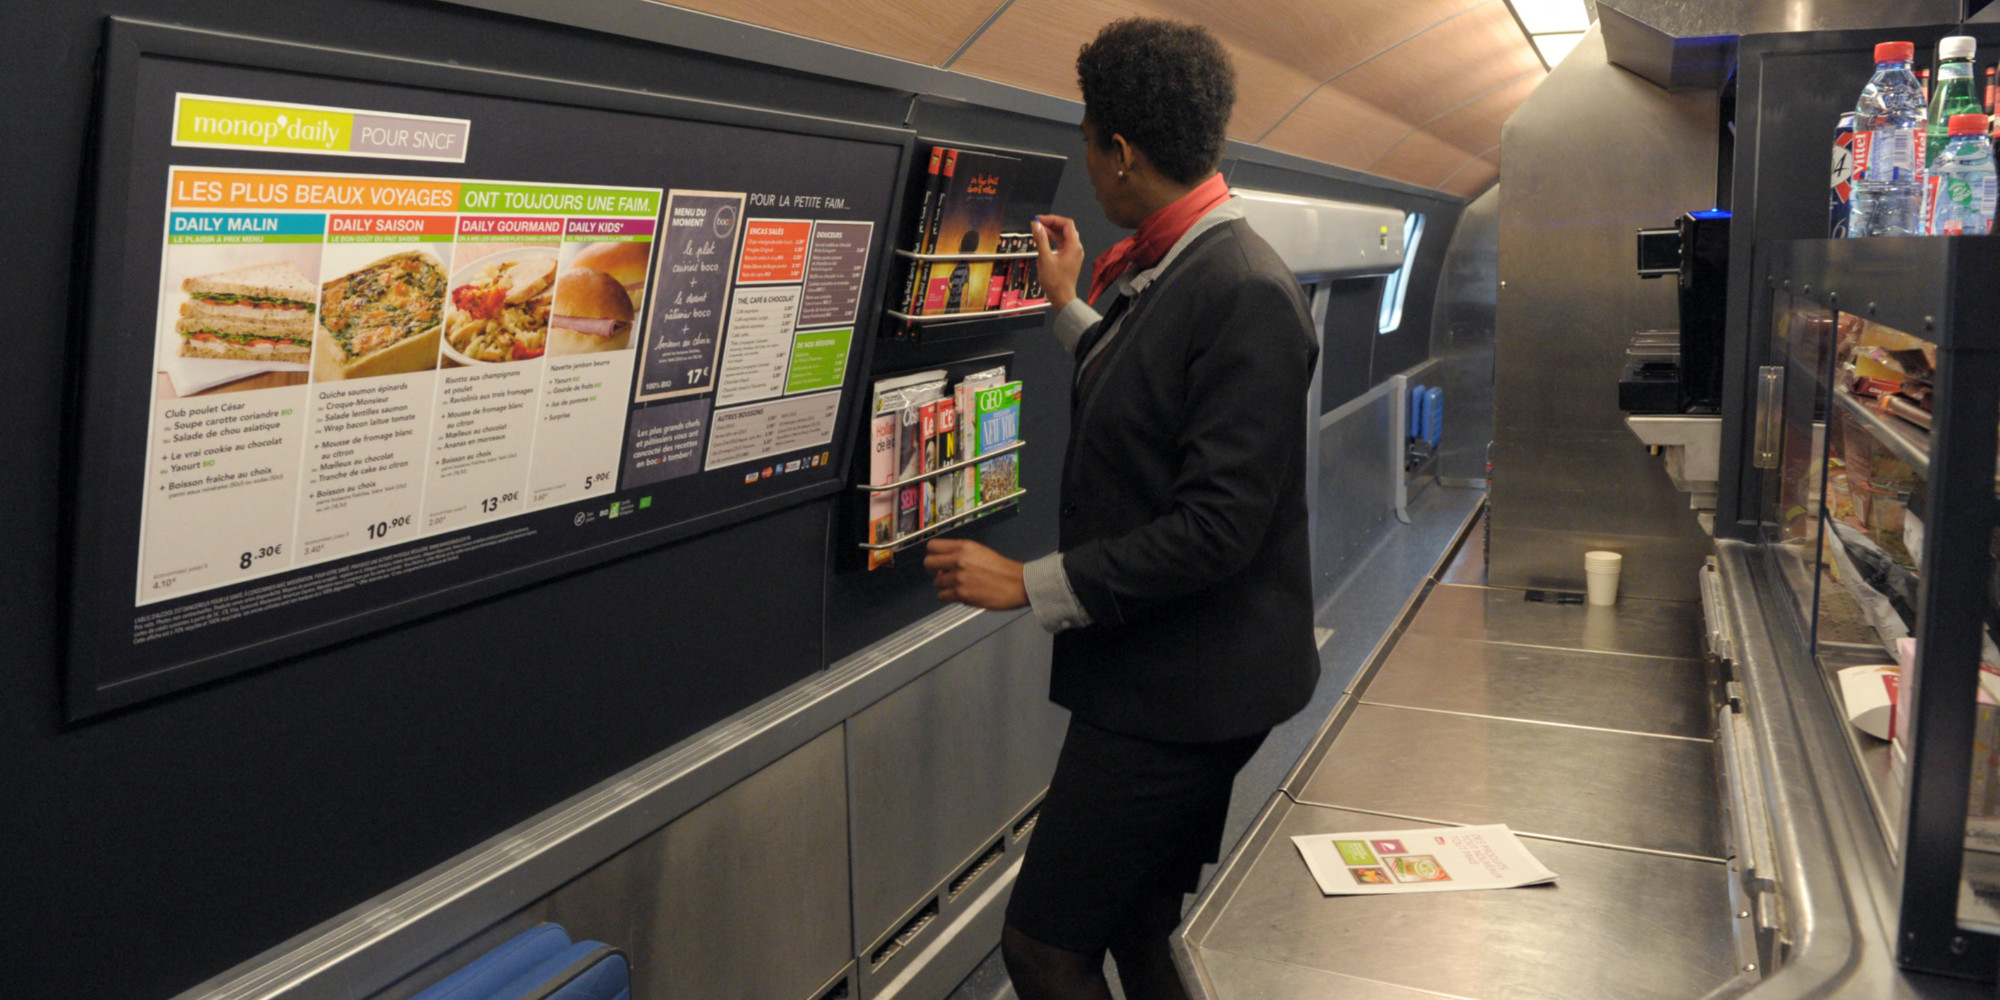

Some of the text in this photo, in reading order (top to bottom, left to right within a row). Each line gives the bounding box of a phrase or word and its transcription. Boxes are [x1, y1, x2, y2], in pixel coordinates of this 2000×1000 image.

[360, 126, 456, 151] POUR SNCF
[1853, 133, 1867, 174] Vittel
[1915, 132, 1926, 173] Vittel
[178, 180, 651, 212] LES PLUS BEAUX VOYAGES ONT TOUJOURS UNE FAIM.
[749, 193, 776, 206] POUR
[779, 195, 790, 207] LA
[794, 196, 822, 208] PETITE
[674, 207, 706, 217] MENU DU
[174, 217, 278, 231] DAILY MALIN
[333, 218, 424, 232] DAILY SAISON
[462, 220, 560, 233] DAILY GOURMAND
[568, 221, 596, 233] DAILY
[672, 218, 705, 227] MOMENT
[701, 260, 719, 272] boco
[768, 295, 795, 303] CHOCOLAT
[693, 309, 711, 318] boco
[452, 385, 473, 396] poulet
[661, 380, 672, 389] BIO
[318, 389, 346, 400] Quiche
[347, 387, 376, 396] saumon
[980, 389, 1003, 412] GEO
[164, 402, 246, 419] Club poulet César
[324, 404, 408, 422] Salade lentilles saumon
[173, 419, 203, 431] Soupe
[205, 415, 238, 426] carotte
[239, 410, 280, 422] coriandre
[323, 424, 344, 433] Wrap
[345, 420, 369, 430] bacon
[391, 414, 416, 423] tomate
[924, 416, 934, 436] Le
[172, 422, 281, 444] Salade de chou asiatique
[637, 428, 648, 438] Les
[649, 425, 663, 437] plus
[663, 423, 684, 435] grands
[983, 412, 1017, 445] NEW YORK
[321, 439, 350, 449] Mousse
[352, 436, 362, 444] de
[363, 432, 394, 443] fromage
[673, 434, 687, 442] vous
[688, 431, 699, 439] ont
[170, 437, 283, 461] Le vrai cookie au chocolat
[332, 449, 354, 458] citron
[662, 445, 674, 454] des
[674, 440, 698, 452] recettes
[353, 457, 363, 465] au
[364, 452, 394, 463] chocolat
[636, 460, 645, 468] en
[170, 462, 201, 473] Yaourt
[318, 472, 347, 482] Tranche
[349, 468, 359, 476] de
[360, 465, 377, 475] cake
[388, 461, 408, 470] citron
[168, 479, 204, 491] Boisson
[205, 472, 236, 484] fraîche
[236, 470, 248, 479] au
[249, 466, 273, 478] choix
[480, 491, 520, 514] 13.90€
[366, 514, 411, 540] 10.90€
[239, 543, 283, 570] 8.30€
